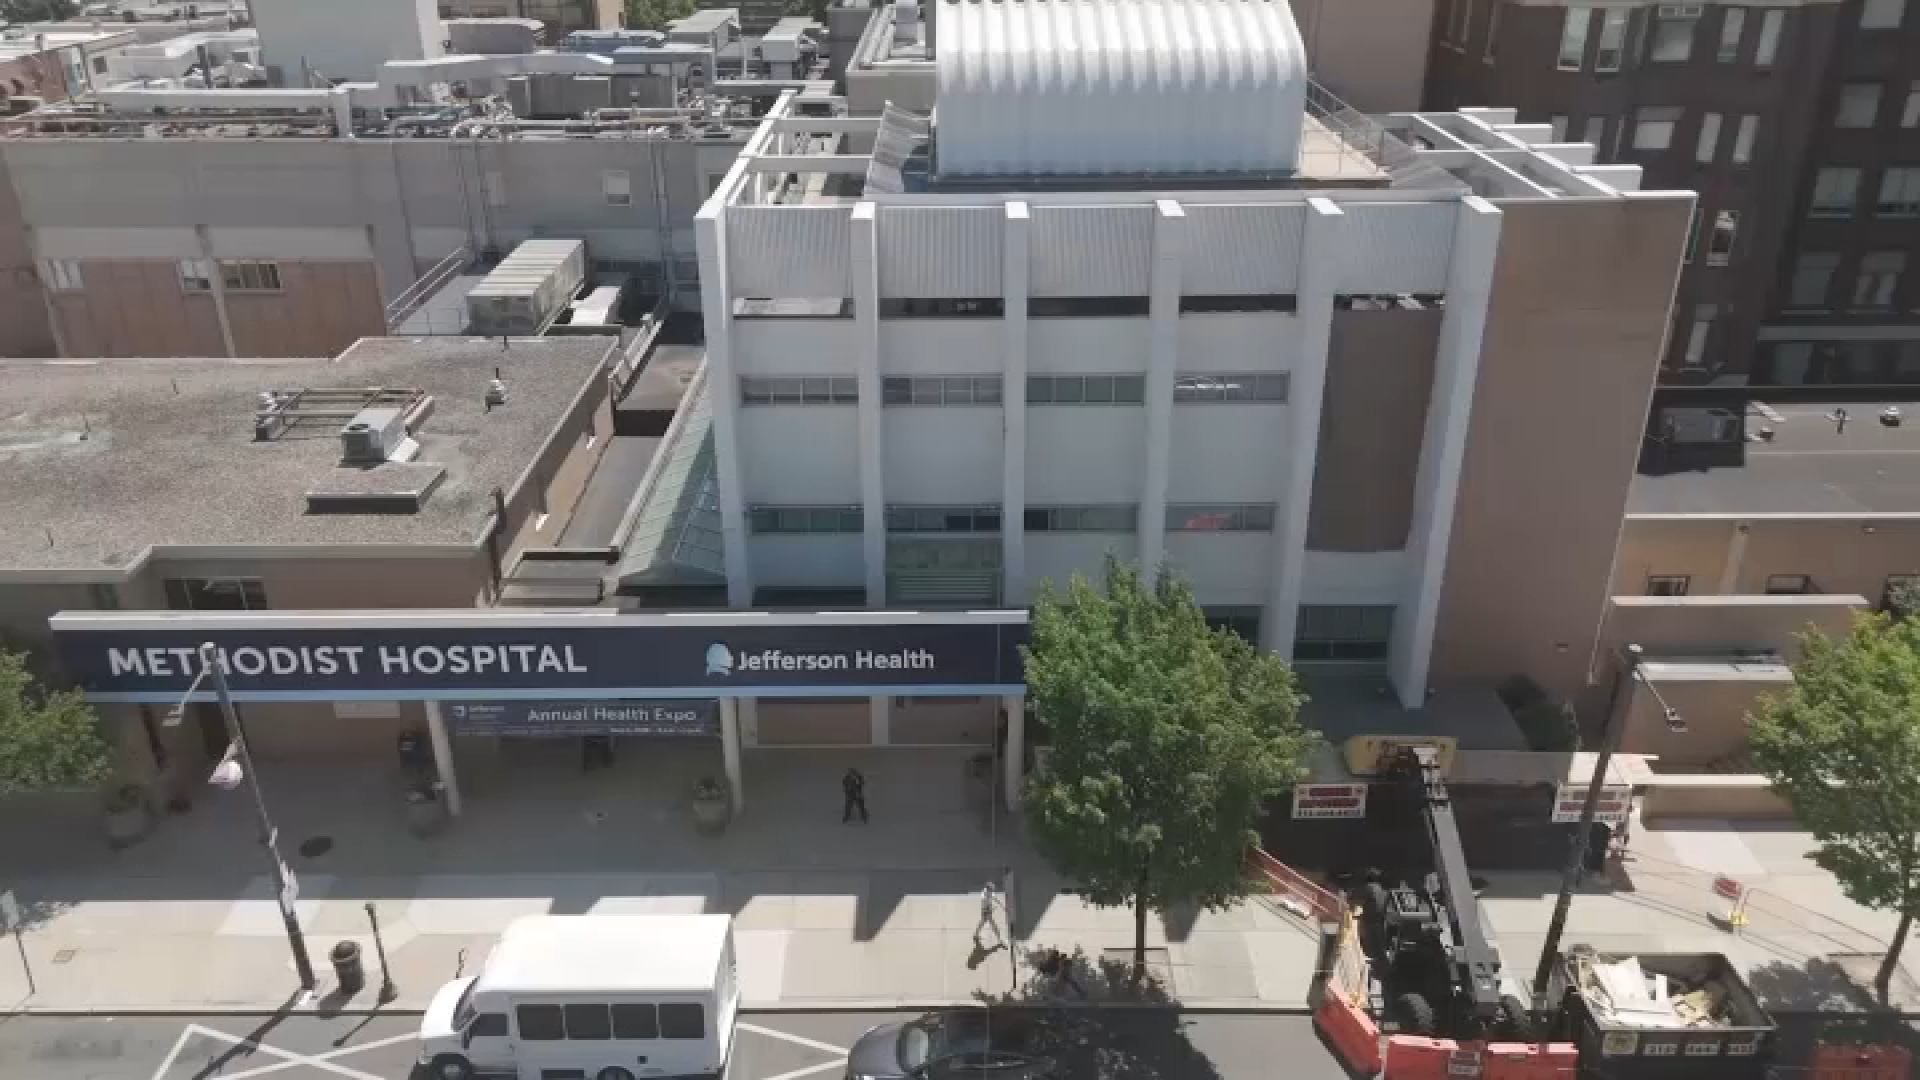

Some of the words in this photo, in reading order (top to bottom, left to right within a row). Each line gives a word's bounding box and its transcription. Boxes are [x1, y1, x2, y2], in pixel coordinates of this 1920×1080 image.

[108, 645, 364, 676] METHODIST
[380, 644, 588, 674] HOSPITAL
[738, 649, 848, 671] Jefferson
[855, 648, 935, 669] Health
[527, 707, 588, 721] Annual
[594, 707, 648, 721] Health
[655, 707, 697, 723] Expo
